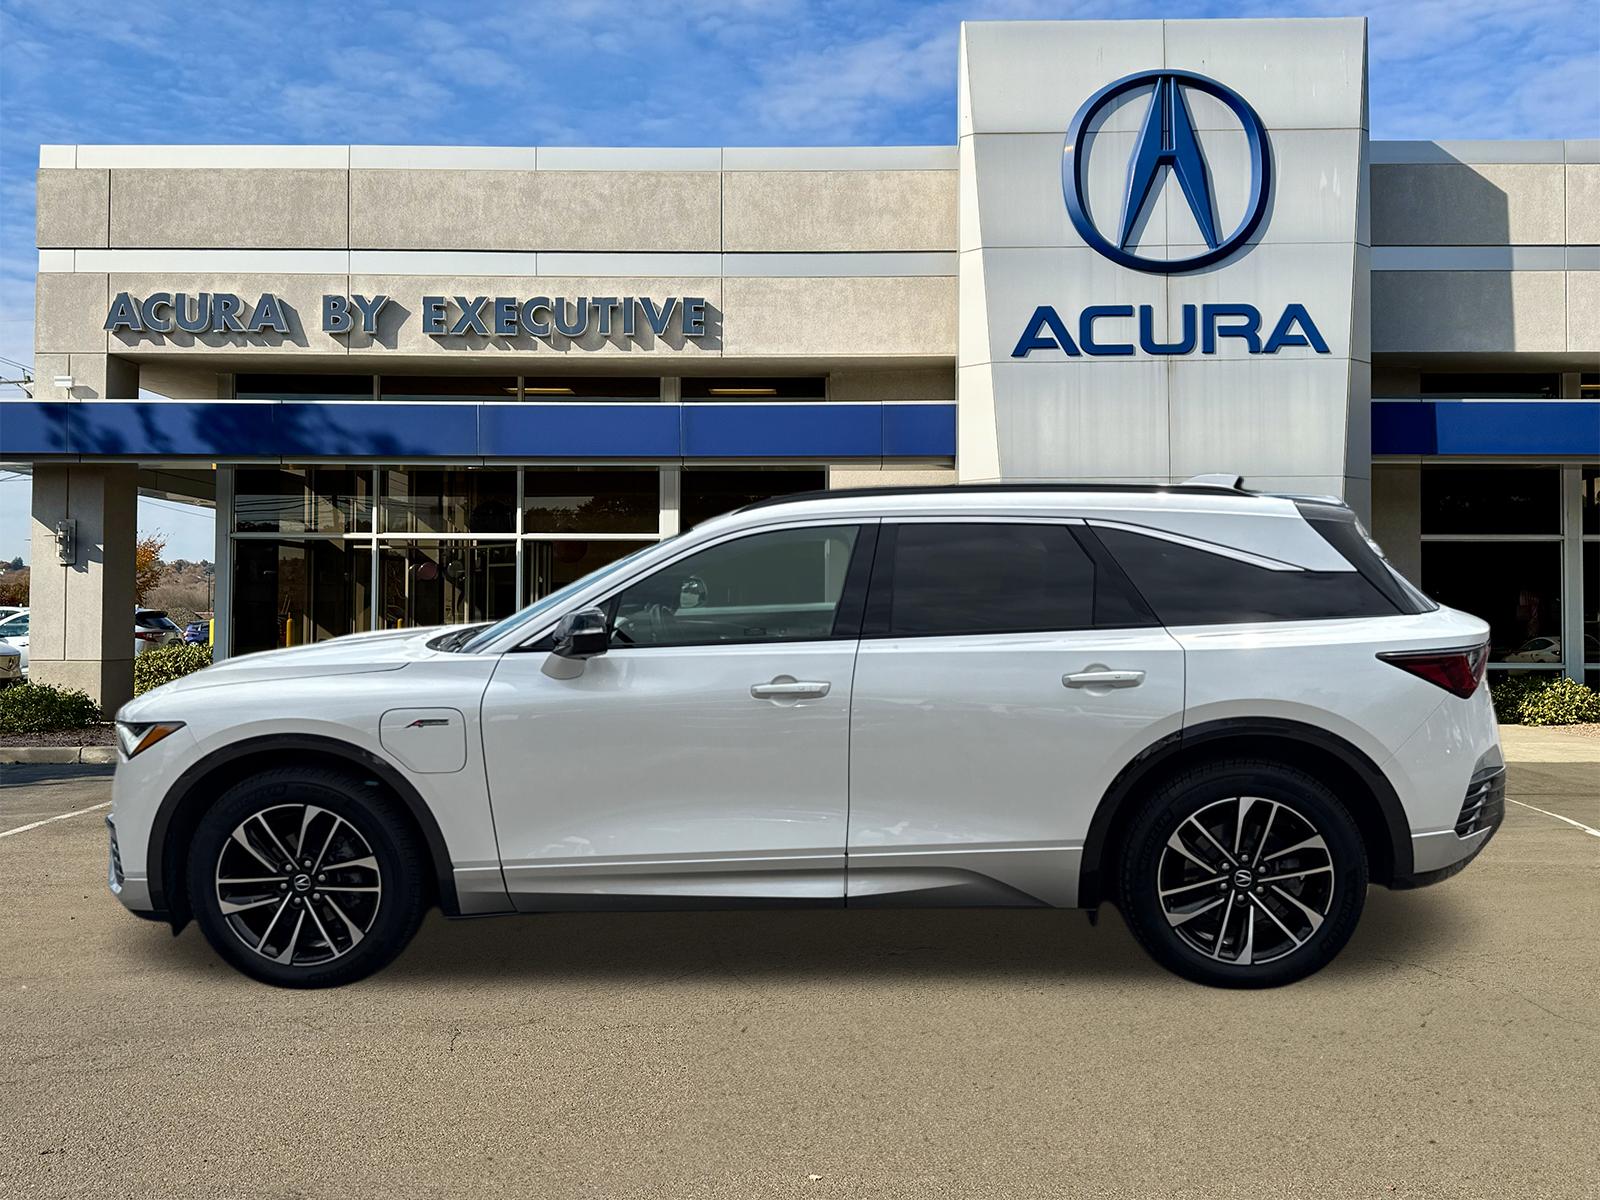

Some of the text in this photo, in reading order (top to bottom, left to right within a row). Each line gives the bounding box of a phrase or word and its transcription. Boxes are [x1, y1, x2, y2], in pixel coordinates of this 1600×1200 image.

[103, 292, 706, 337] ACURA BY EXECUTIVE
[1011, 303, 1332, 357] ACURA
